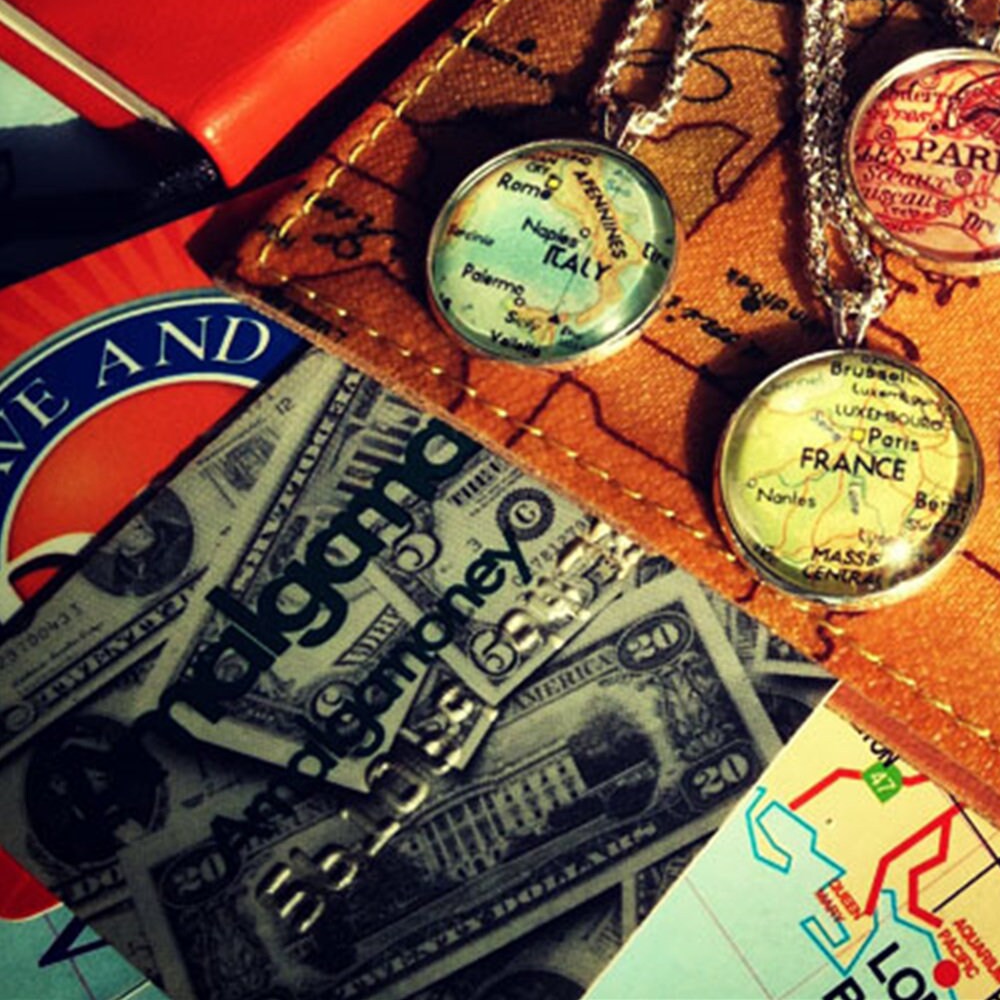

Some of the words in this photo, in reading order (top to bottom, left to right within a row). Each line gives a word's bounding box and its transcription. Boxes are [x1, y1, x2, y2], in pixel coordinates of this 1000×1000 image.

[496, 171, 554, 201] Rome
[521, 216, 578, 249] Naples
[461, 262, 526, 296] Palermo
[542, 244, 612, 281] ITALY
[95, 315, 271, 389] AND
[867, 427, 920, 452] Paris
[800, 447, 908, 482] FRANCE
[756, 487, 817, 509] Nantes
[624, 618, 684, 661] 20
[692, 751, 751, 796] 20
[869, 769, 897, 794] 47
